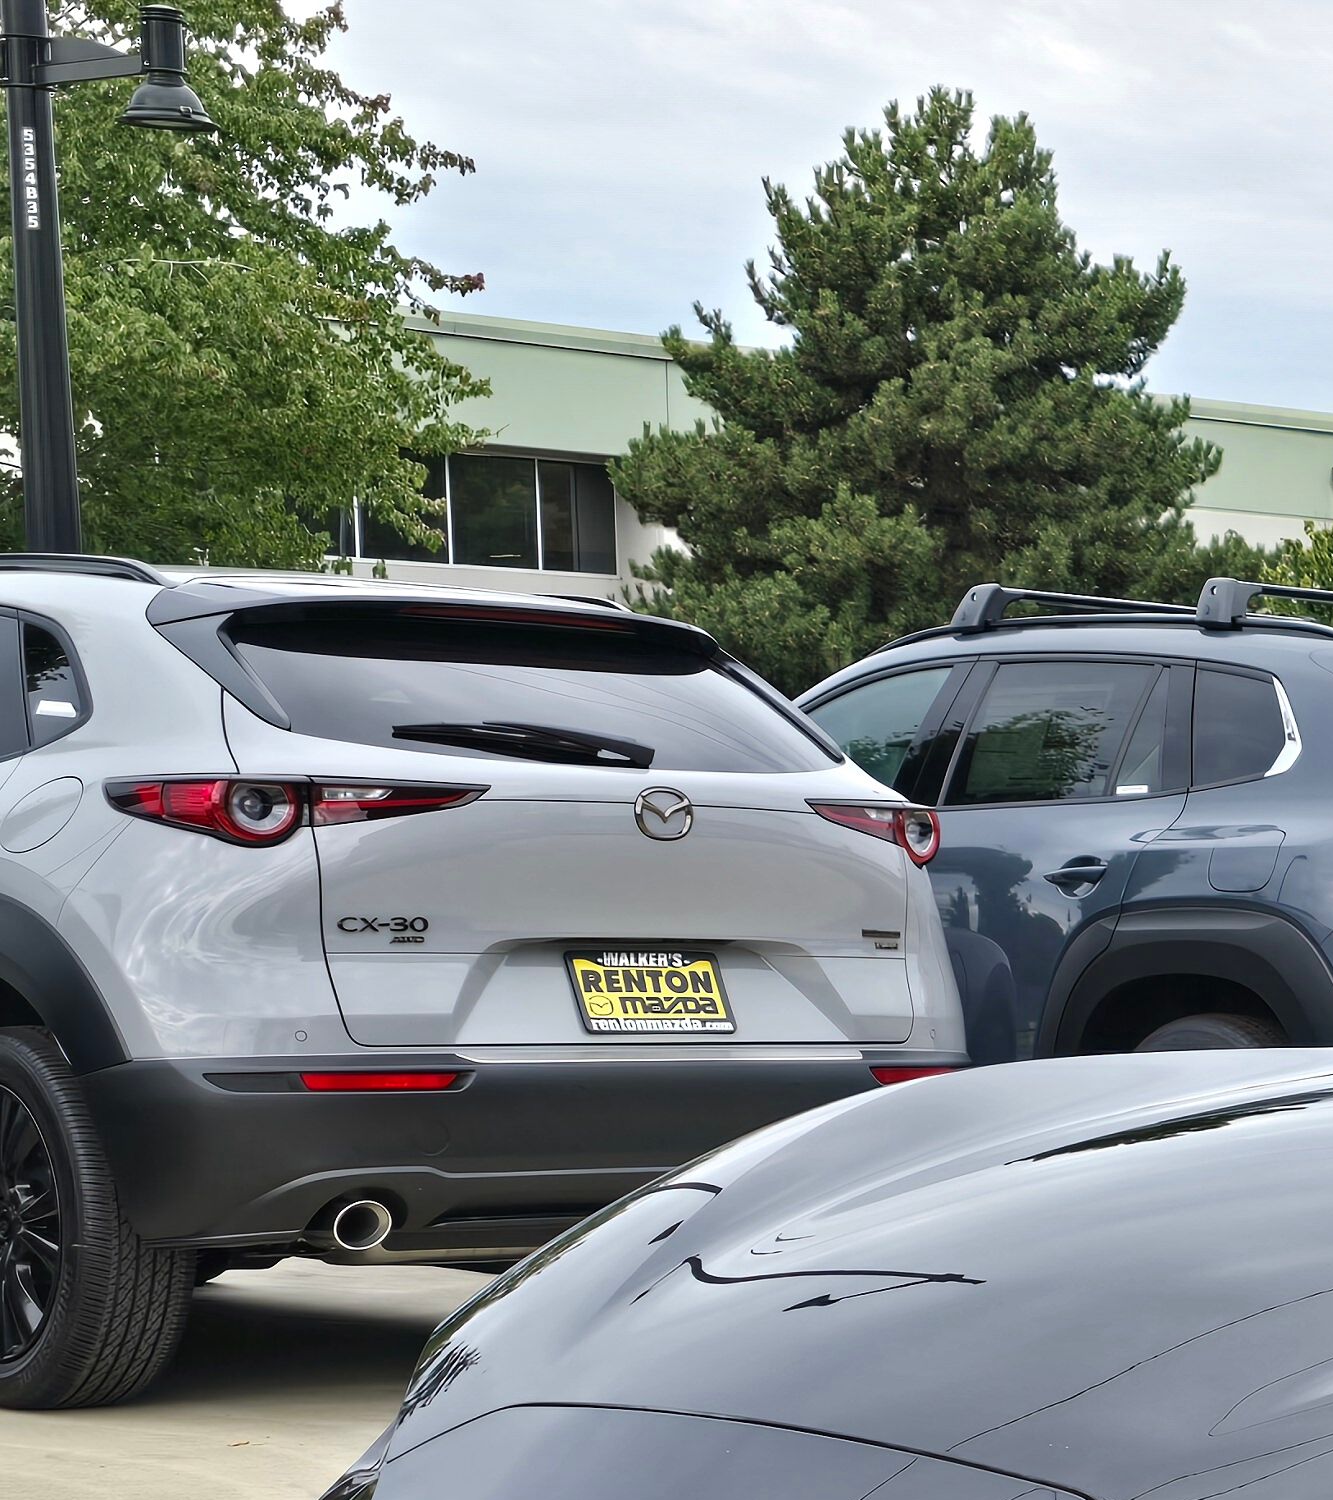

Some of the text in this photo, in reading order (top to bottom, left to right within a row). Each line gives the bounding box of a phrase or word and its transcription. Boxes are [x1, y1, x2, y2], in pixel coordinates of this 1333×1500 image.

[337, 916, 429, 933] CX-30
[602, 952, 683, 968] WALKER'S
[580, 969, 714, 994] RENTON
[618, 996, 720, 1015] mazda
